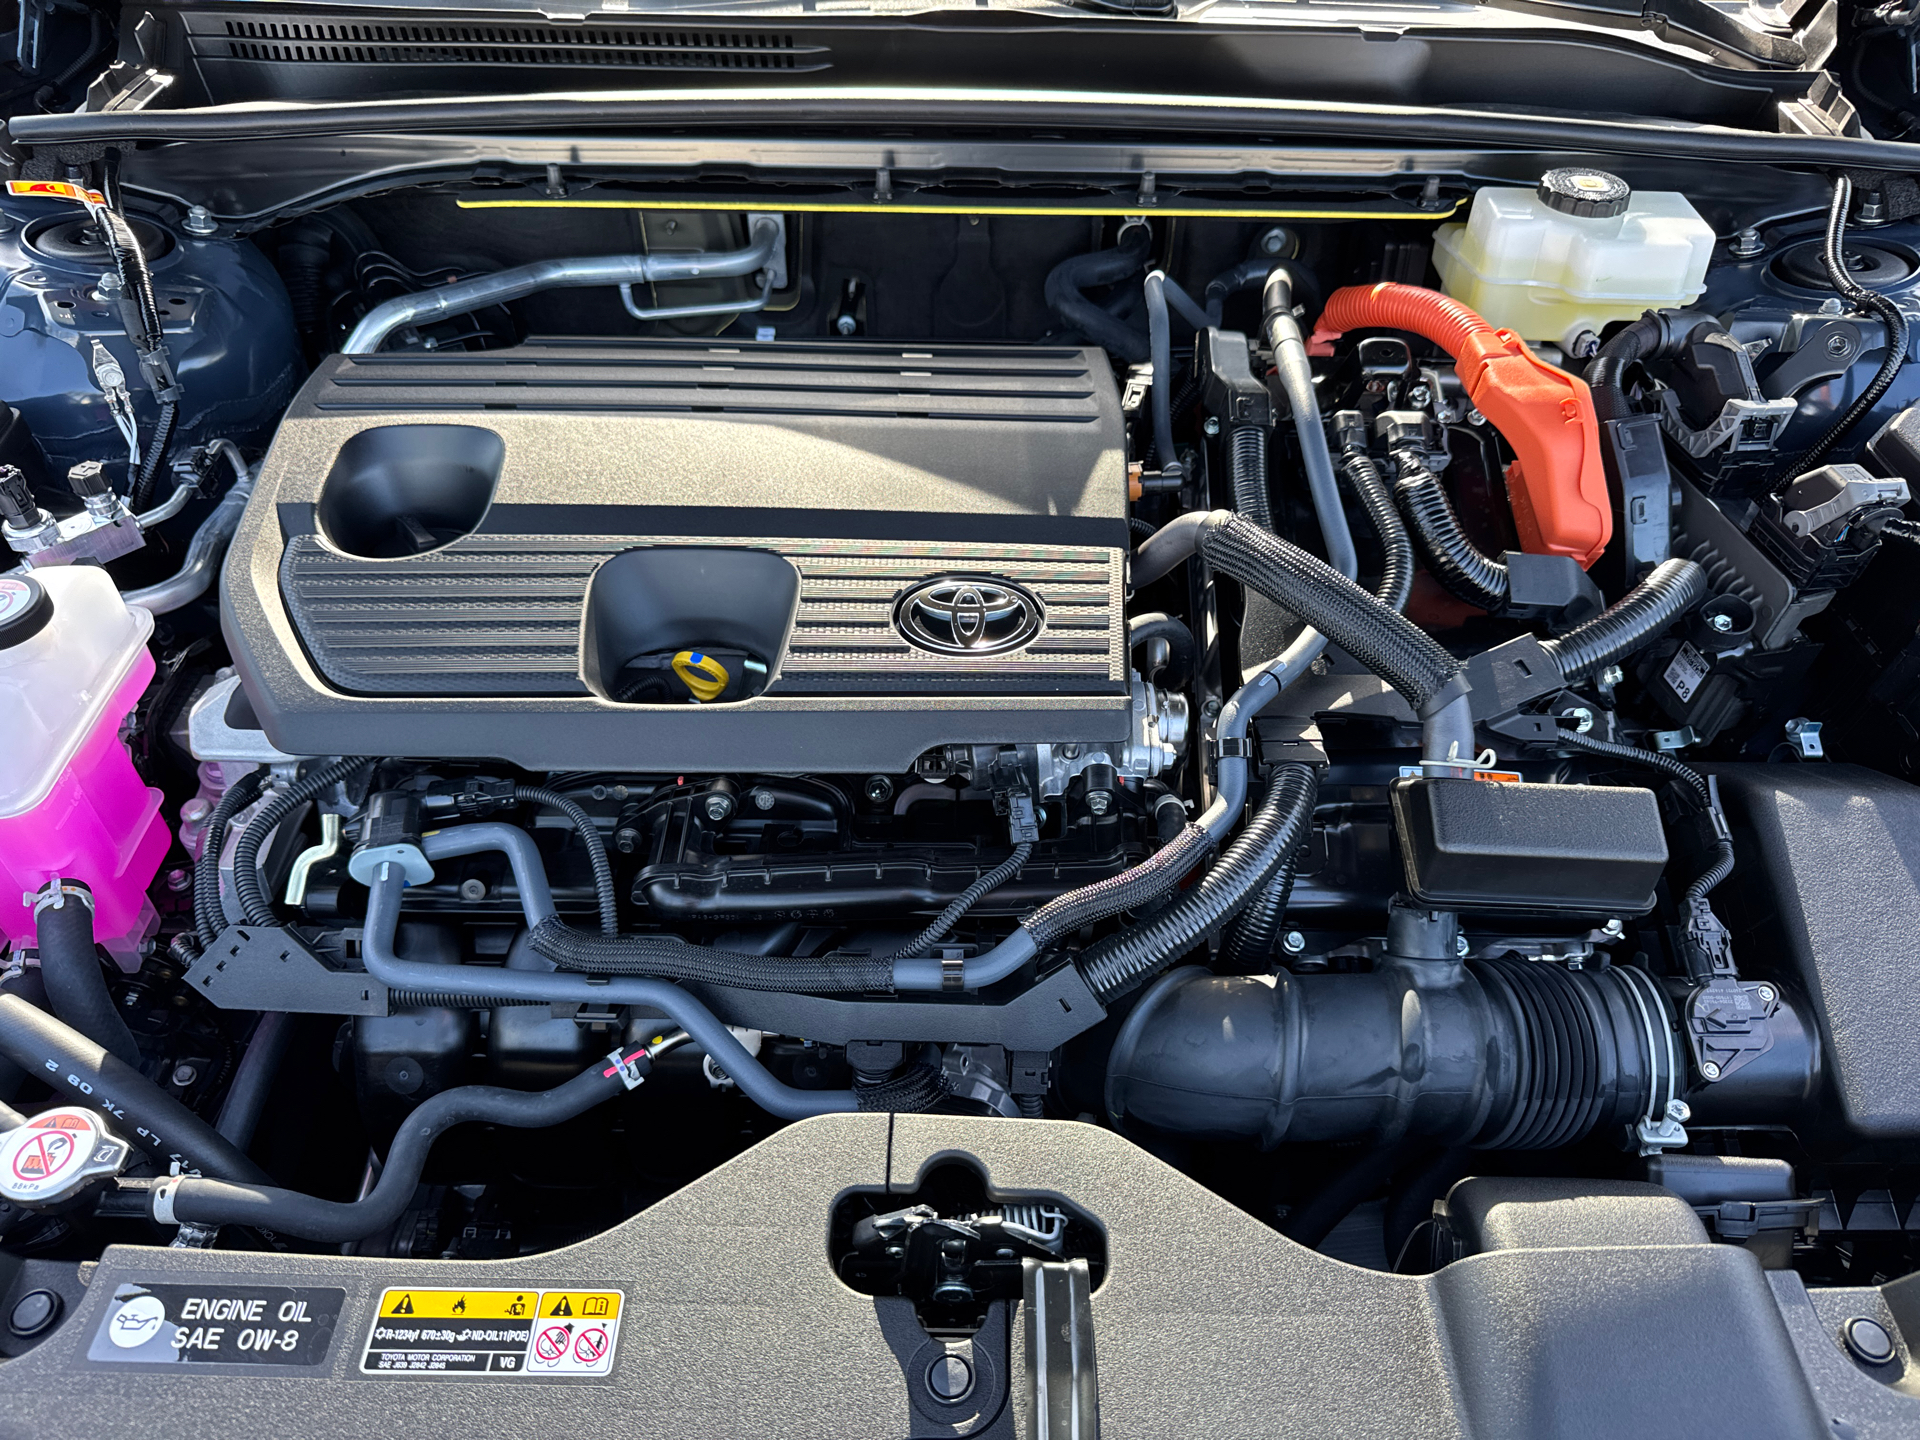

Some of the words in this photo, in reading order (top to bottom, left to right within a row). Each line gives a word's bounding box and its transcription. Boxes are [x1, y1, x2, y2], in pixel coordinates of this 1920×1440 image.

[1675, 680, 1690, 699] P8
[45, 1058, 60, 1073] 2
[67, 1074, 94, 1096] 09
[101, 1098, 125, 1120] 7K
[136, 1126, 162, 1147] LP
[181, 1298, 268, 1322] ENGINE
[277, 1301, 312, 1323] OIL
[170, 1327, 225, 1350] SAE
[237, 1329, 299, 1352] 0W-8
[385, 1329, 420, 1343] R-1234yf
[421, 1329, 456, 1344] 670±30g
[377, 1361, 392, 1369] SAE
[381, 1353, 406, 1361] TOYOTA
[407, 1353, 431, 1362] MOTOR
[431, 1354, 476, 1363] CORPORATION
[500, 1356, 517, 1369] VG
